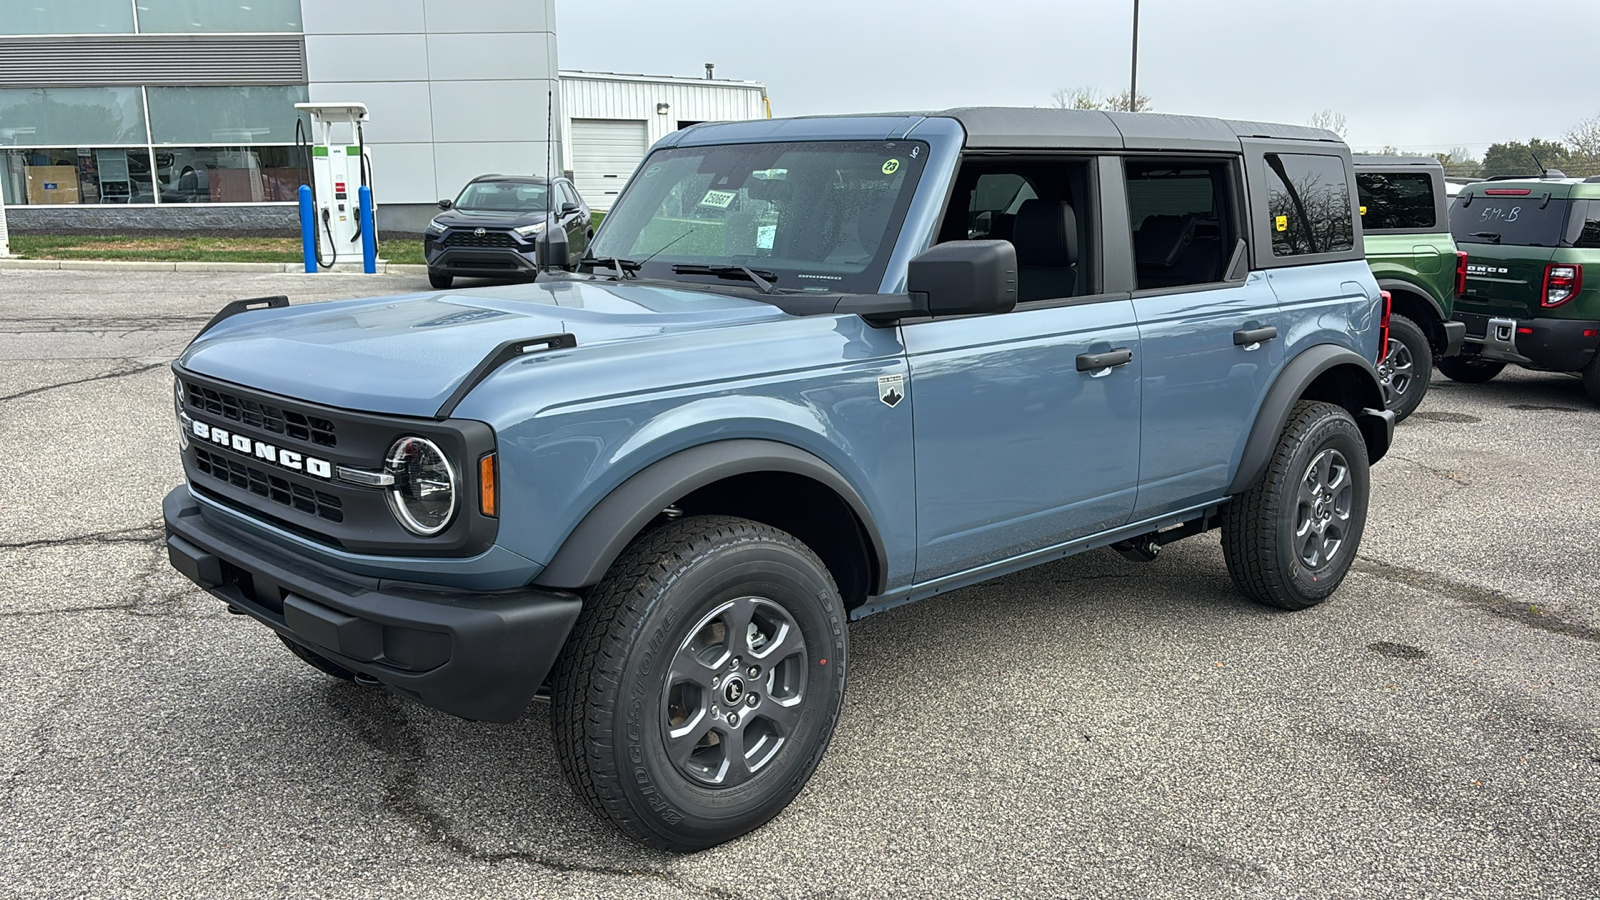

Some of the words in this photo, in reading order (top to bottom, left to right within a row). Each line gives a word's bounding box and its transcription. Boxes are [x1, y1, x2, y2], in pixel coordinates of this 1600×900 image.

[884, 161, 898, 171] 23
[1467, 265, 1508, 273] ONCO
[192, 420, 331, 478] BRONCO
[628, 605, 685, 826] BRIDGESTONE
